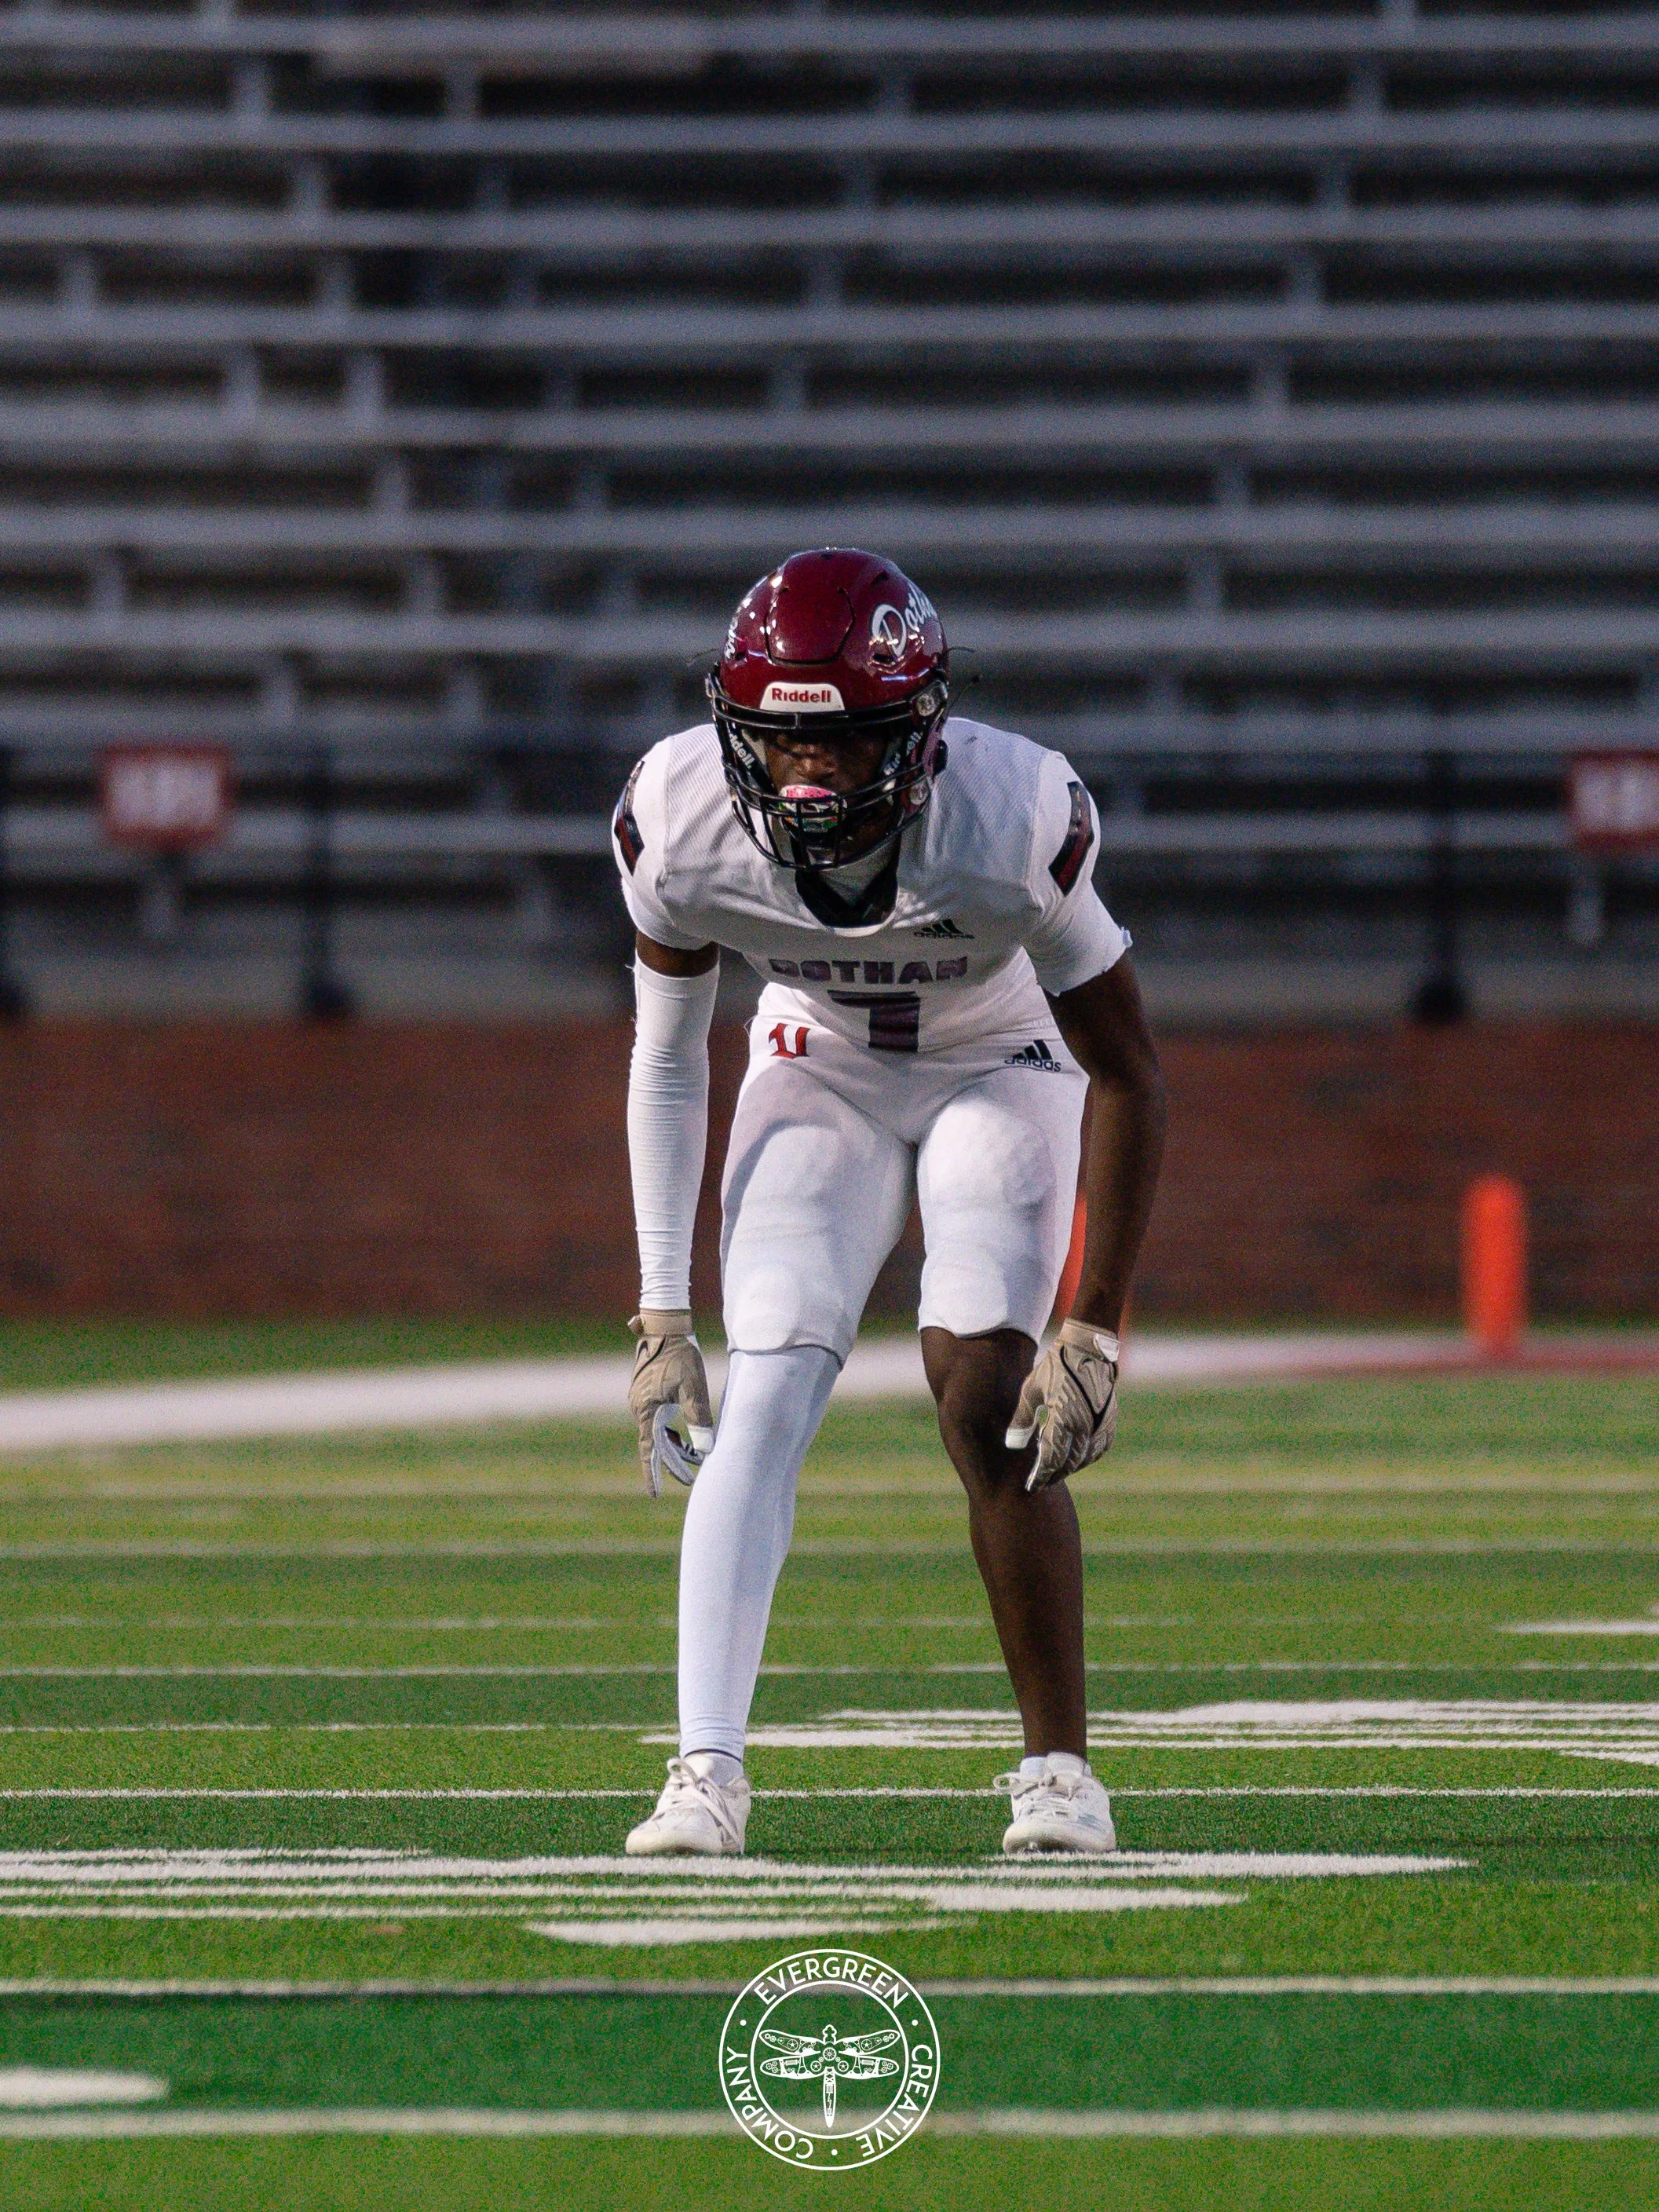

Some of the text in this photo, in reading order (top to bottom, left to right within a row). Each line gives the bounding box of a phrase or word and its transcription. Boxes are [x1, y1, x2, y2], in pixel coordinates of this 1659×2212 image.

[772, 687, 831, 704] Riddell
[768, 956, 968, 985] DOTHAN
[827, 989, 921, 1053] 7
